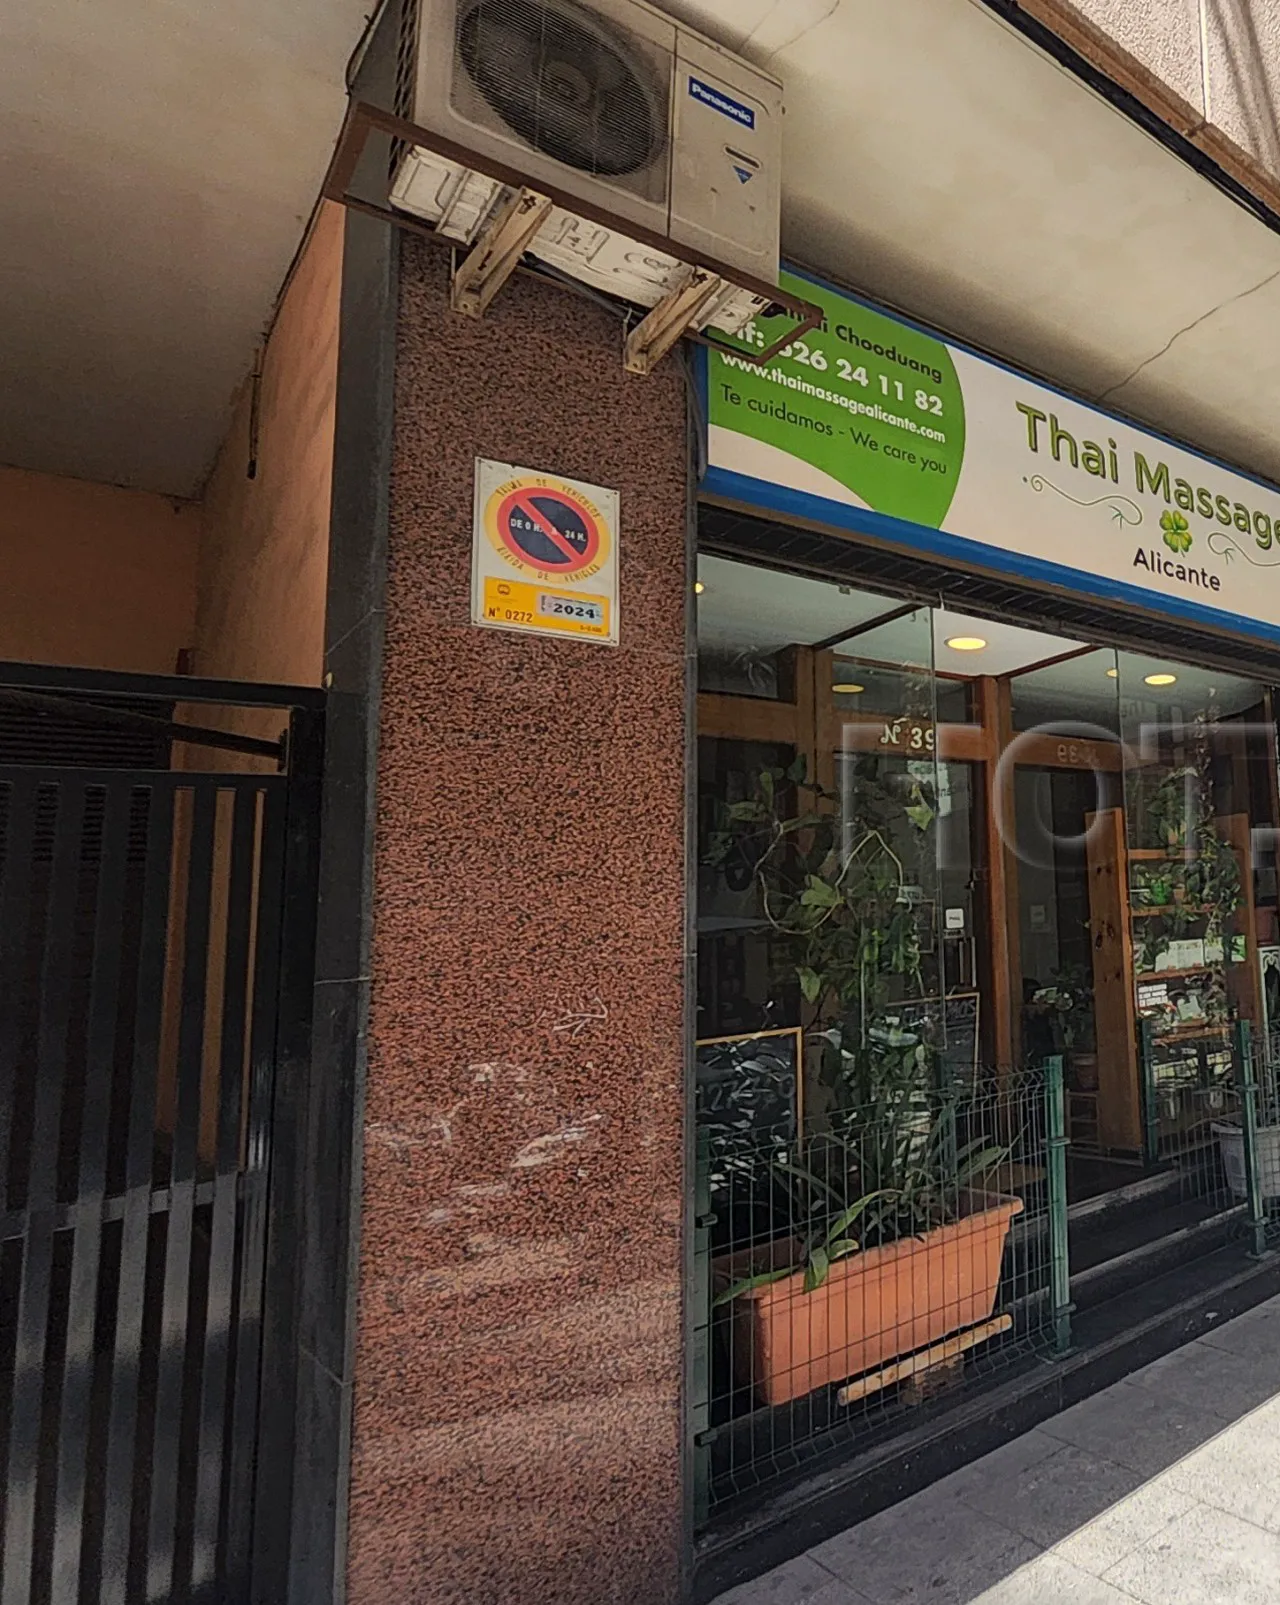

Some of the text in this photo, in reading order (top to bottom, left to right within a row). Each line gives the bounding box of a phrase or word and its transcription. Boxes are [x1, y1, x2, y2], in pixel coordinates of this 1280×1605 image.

[691, 82, 752, 123] Panasonic
[834, 323, 943, 384] Chooduang
[720, 351, 946, 443] www.thaimassagealicante.com
[836, 358, 869, 387] 24
[878, 373, 904, 401] 11
[915, 389, 944, 417] 82
[720, 383, 741, 405] Te
[747, 397, 834, 436] cuidamos
[850, 427, 879, 452] We
[883, 443, 917, 464] care
[920, 456, 947, 475] you
[1015, 400, 1119, 483] Thai
[510, 518, 523, 528] DE
[564, 529, 576, 539] 24
[576, 531, 587, 542] H.
[537, 571, 549, 580] DE
[1132, 547, 1222, 592] Alicante
[504, 609, 533, 623] 0272
[553, 603, 595, 619] 2024
[909, 726, 935, 751] 39
